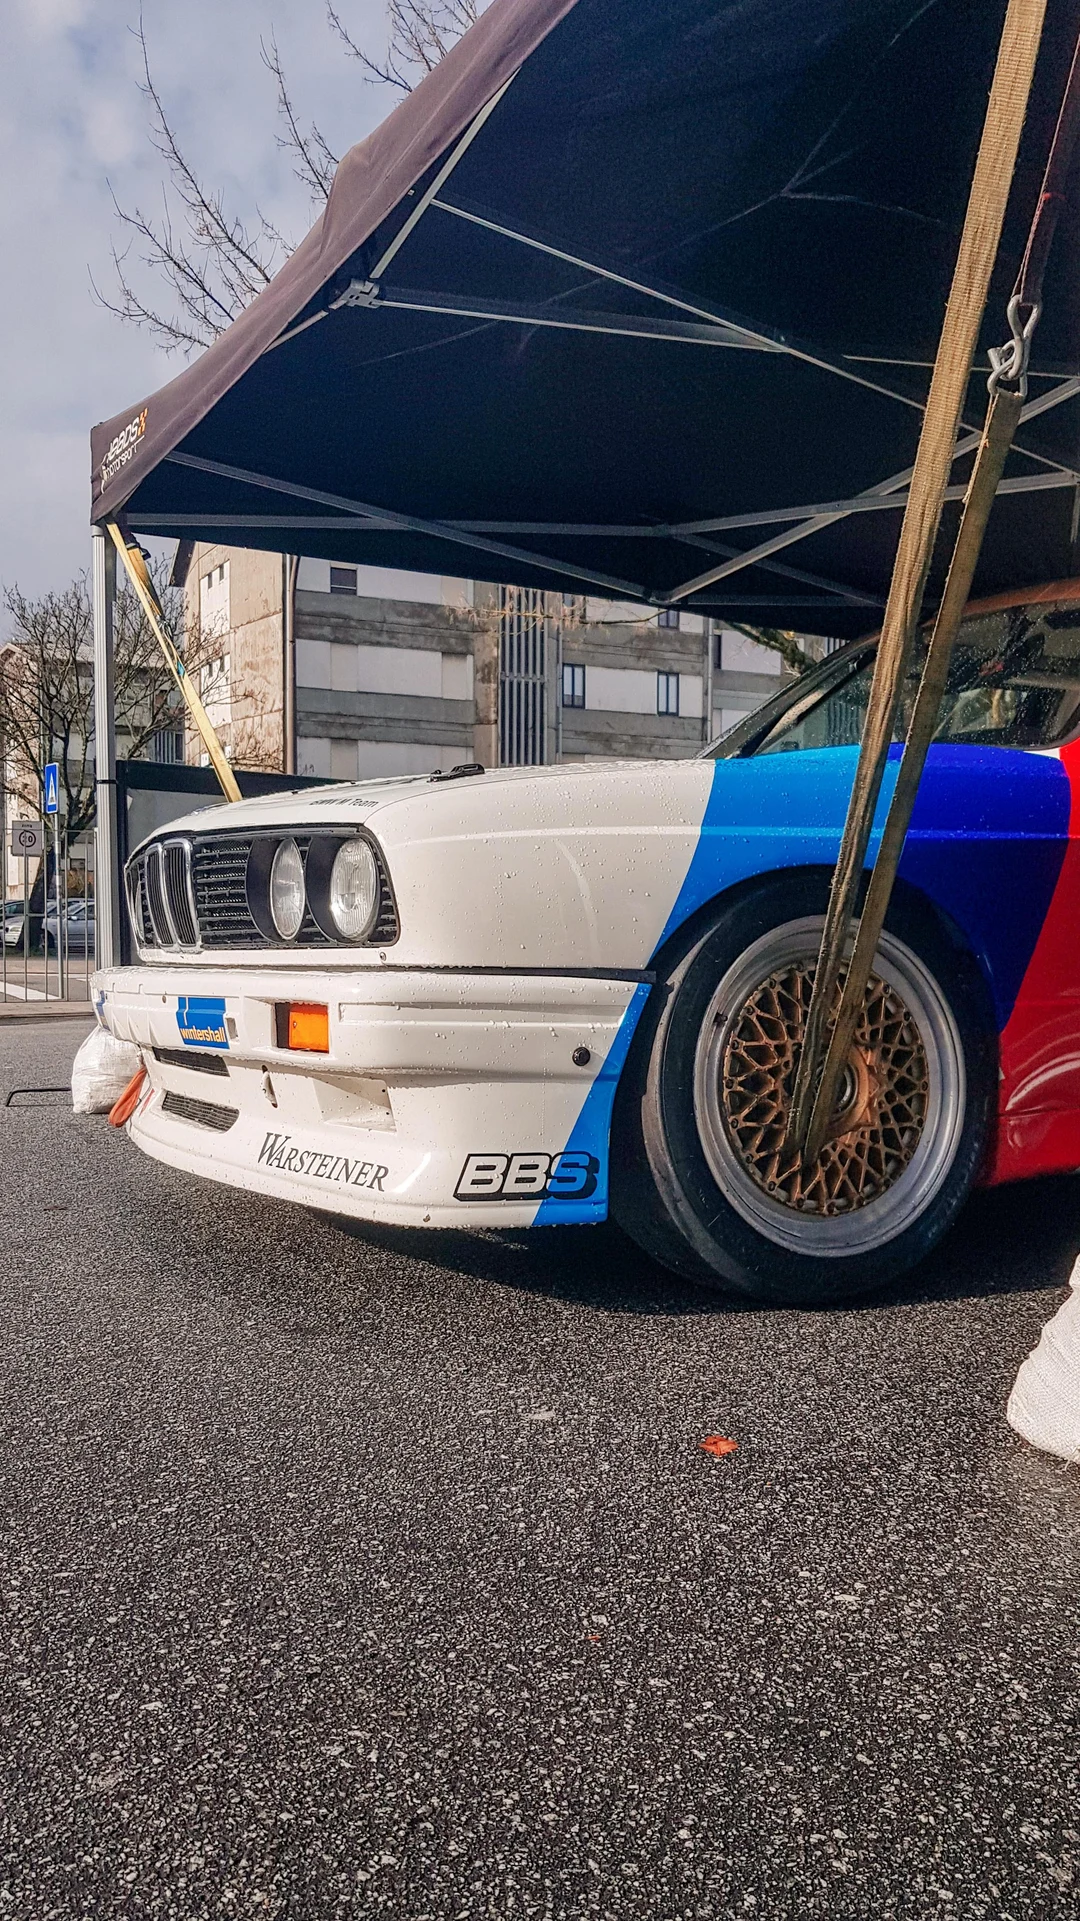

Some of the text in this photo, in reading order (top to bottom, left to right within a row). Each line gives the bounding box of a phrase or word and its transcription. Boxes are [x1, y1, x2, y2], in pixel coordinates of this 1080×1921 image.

[348, 798, 379, 808] Team
[179, 1025, 227, 1043] wintershall
[257, 1132, 389, 1192] WARSTEINER
[453, 1151, 600, 1202] BBS
